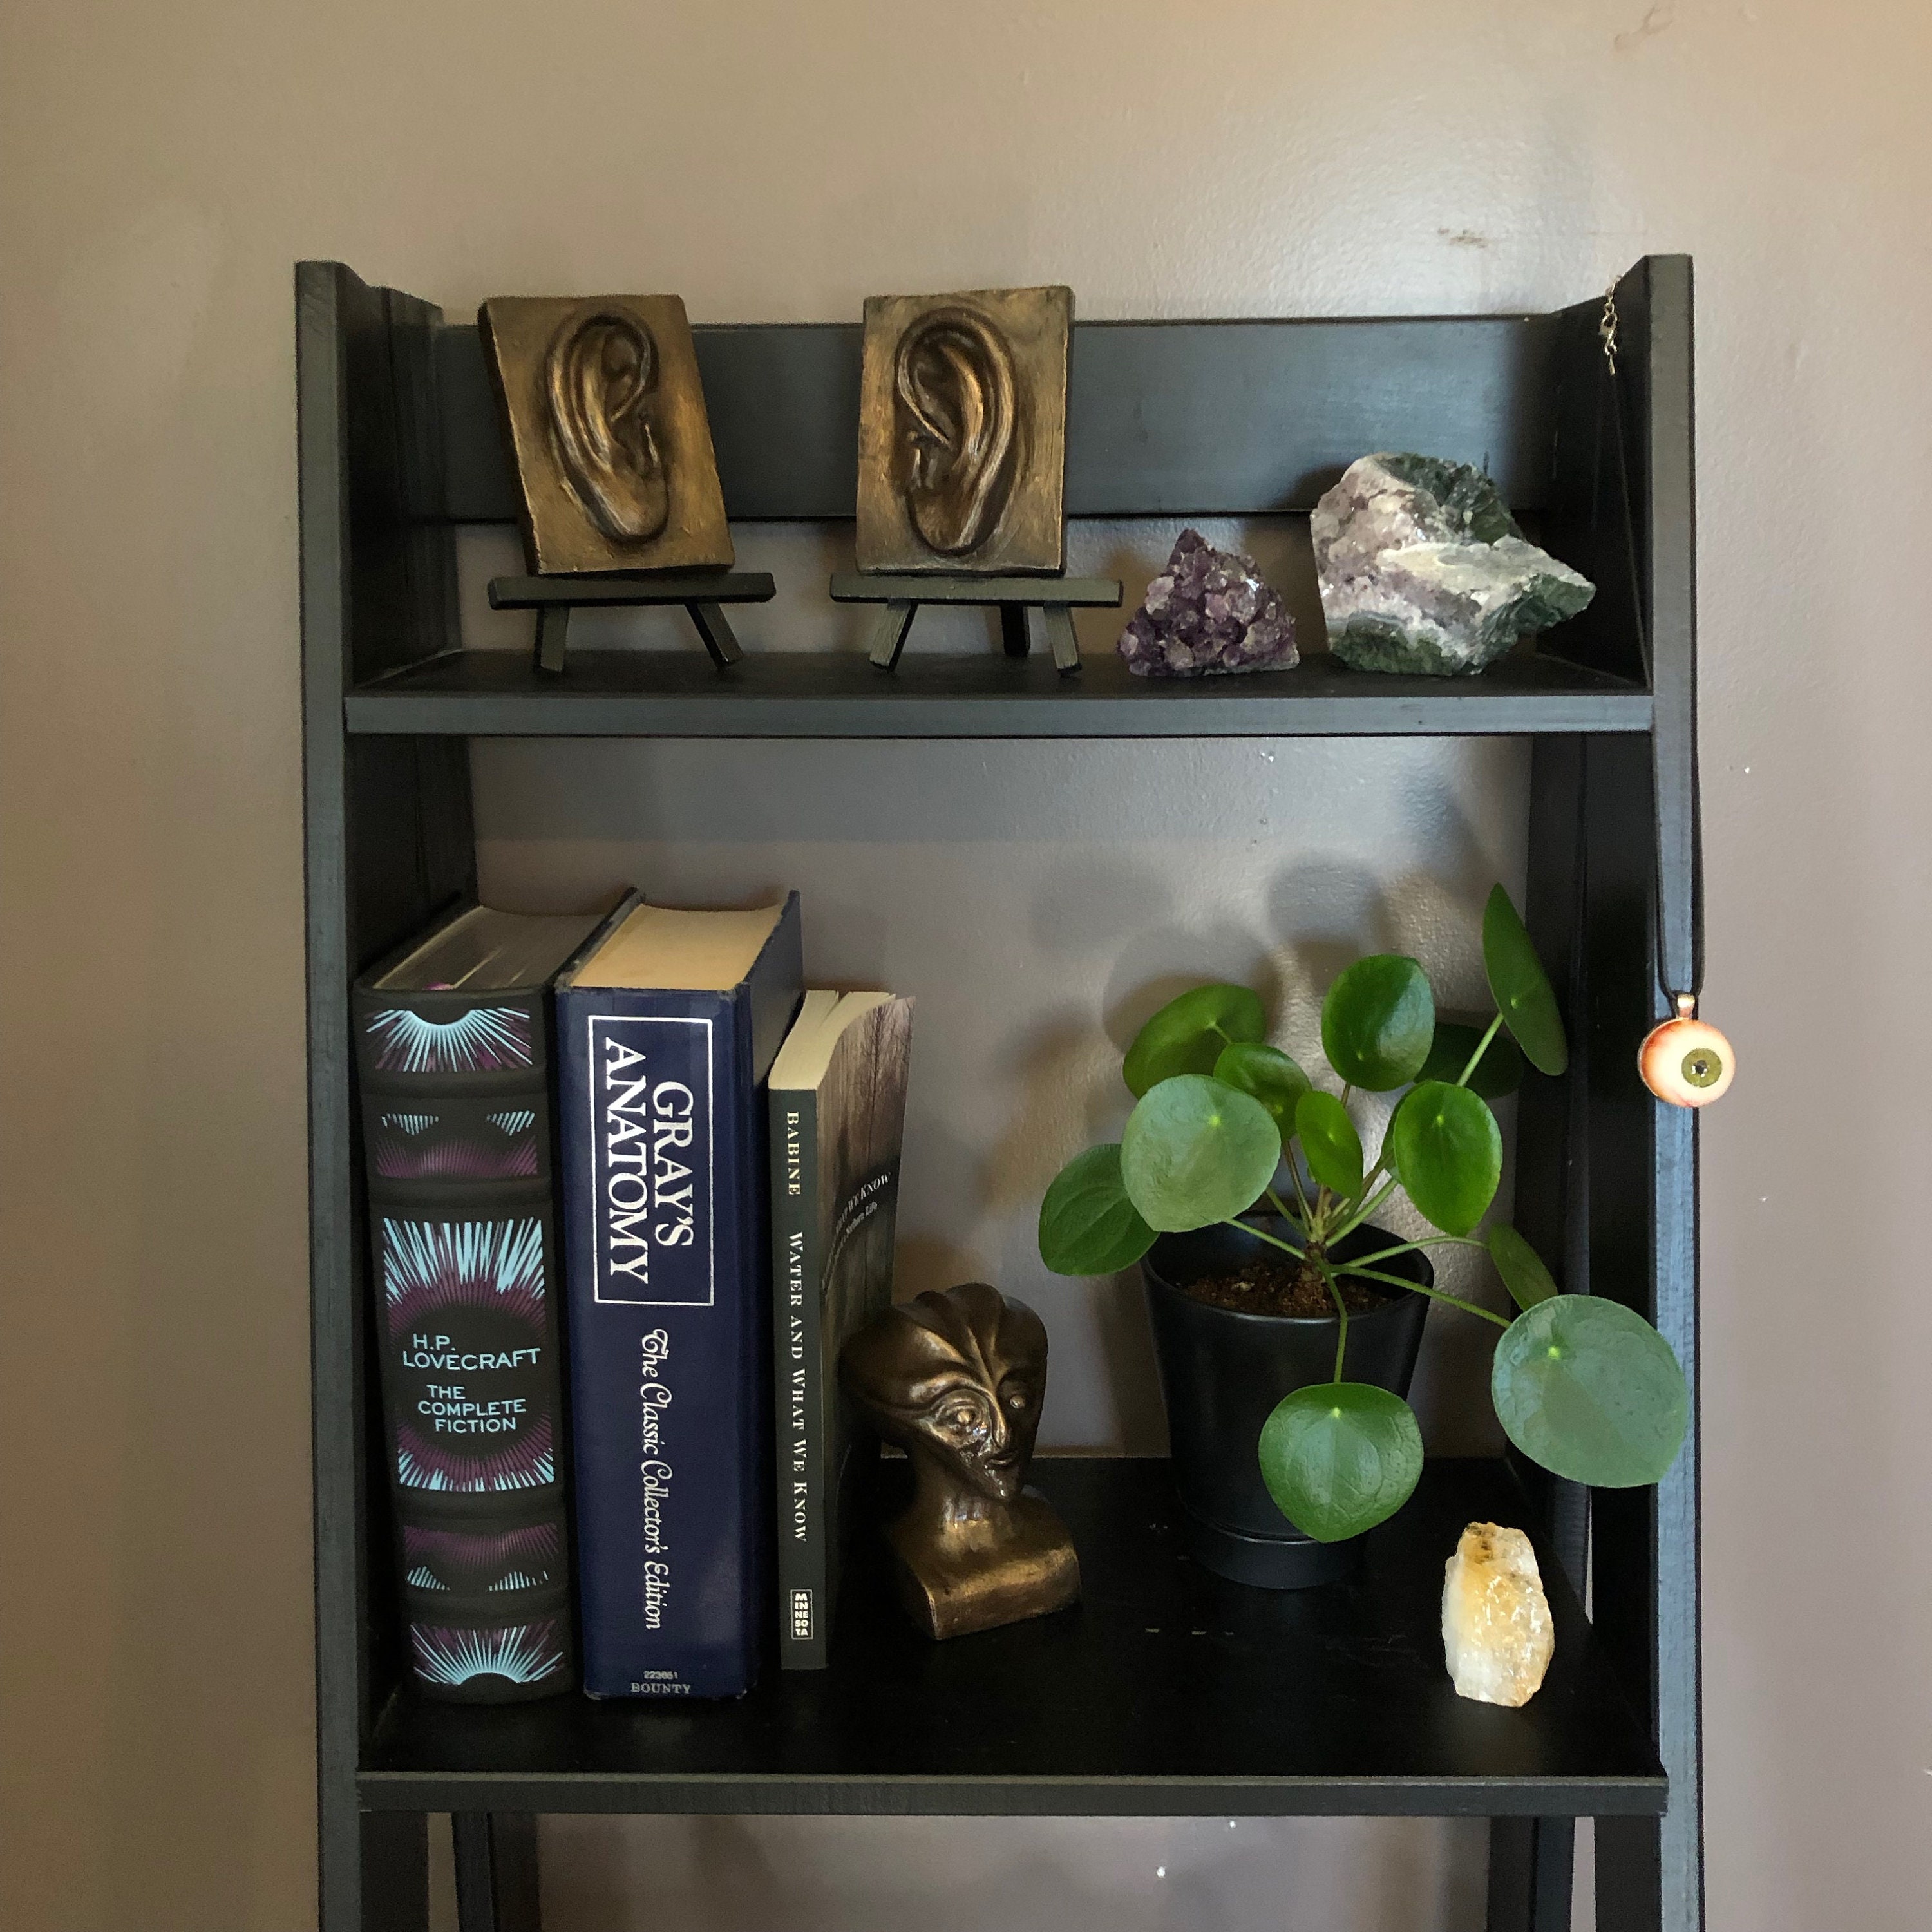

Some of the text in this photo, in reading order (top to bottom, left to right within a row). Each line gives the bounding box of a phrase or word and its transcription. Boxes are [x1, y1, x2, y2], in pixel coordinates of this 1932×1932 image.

[605, 1037, 648, 1284] ANATOMY
[652, 1081, 694, 1245] GRAY'S
[788, 1112, 800, 1195] BABINE
[413, 1334, 455, 1350] H.P.
[403, 1348, 540, 1370] LOVECRAFT
[427, 1385, 465, 1399] THE
[790, 1232, 807, 1541] WATER AND WHAT WE KNOW
[418, 1399, 526, 1416] COMPLETE
[435, 1417, 516, 1433] FICTION
[640, 1329, 672, 1629] The Classic Collector's Edition
[631, 1683, 690, 1694] BOUNTY
